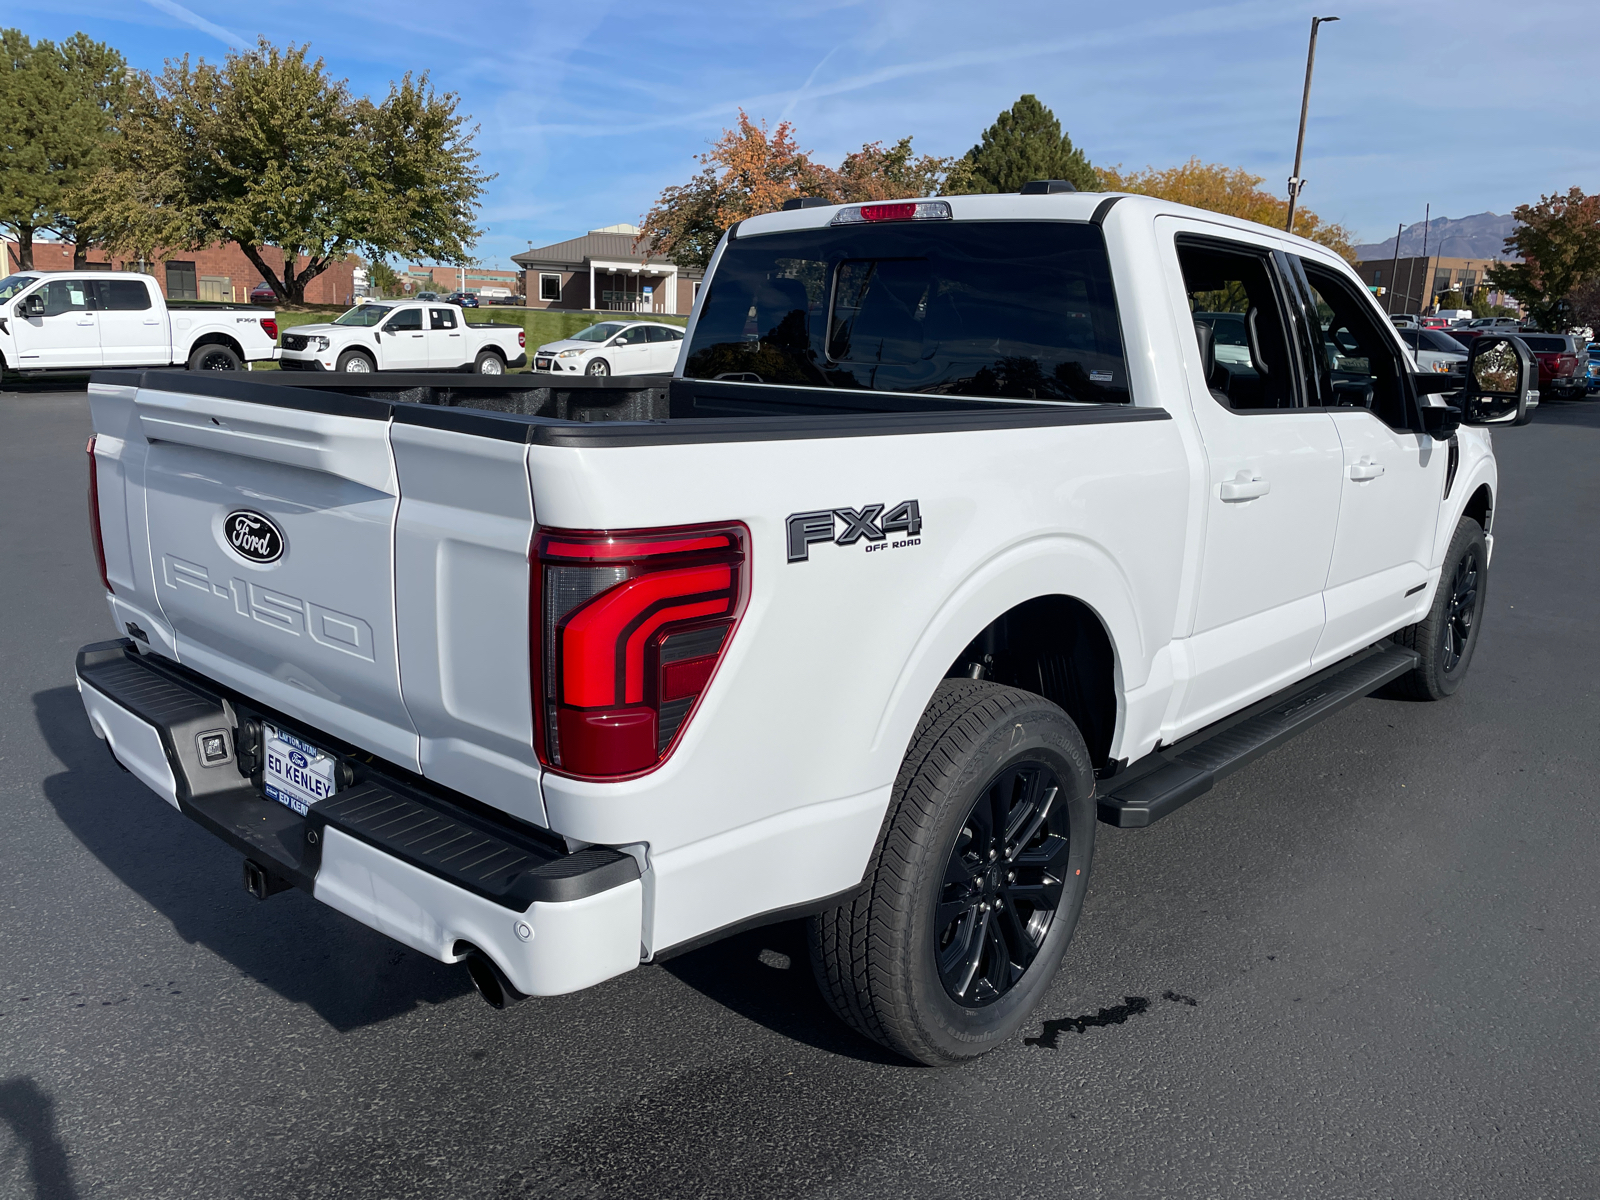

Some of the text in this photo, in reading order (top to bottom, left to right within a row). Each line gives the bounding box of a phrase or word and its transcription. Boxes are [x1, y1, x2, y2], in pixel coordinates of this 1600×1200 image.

[232, 516, 271, 556] Ford
[785, 499, 922, 564] FX4
[865, 538, 921, 553] OFF ROAD
[162, 553, 375, 663] F-150
[268, 754, 281, 774] ED
[286, 763, 330, 799] KENLEY
[291, 752, 305, 767] Ford
[279, 792, 289, 805] ED
